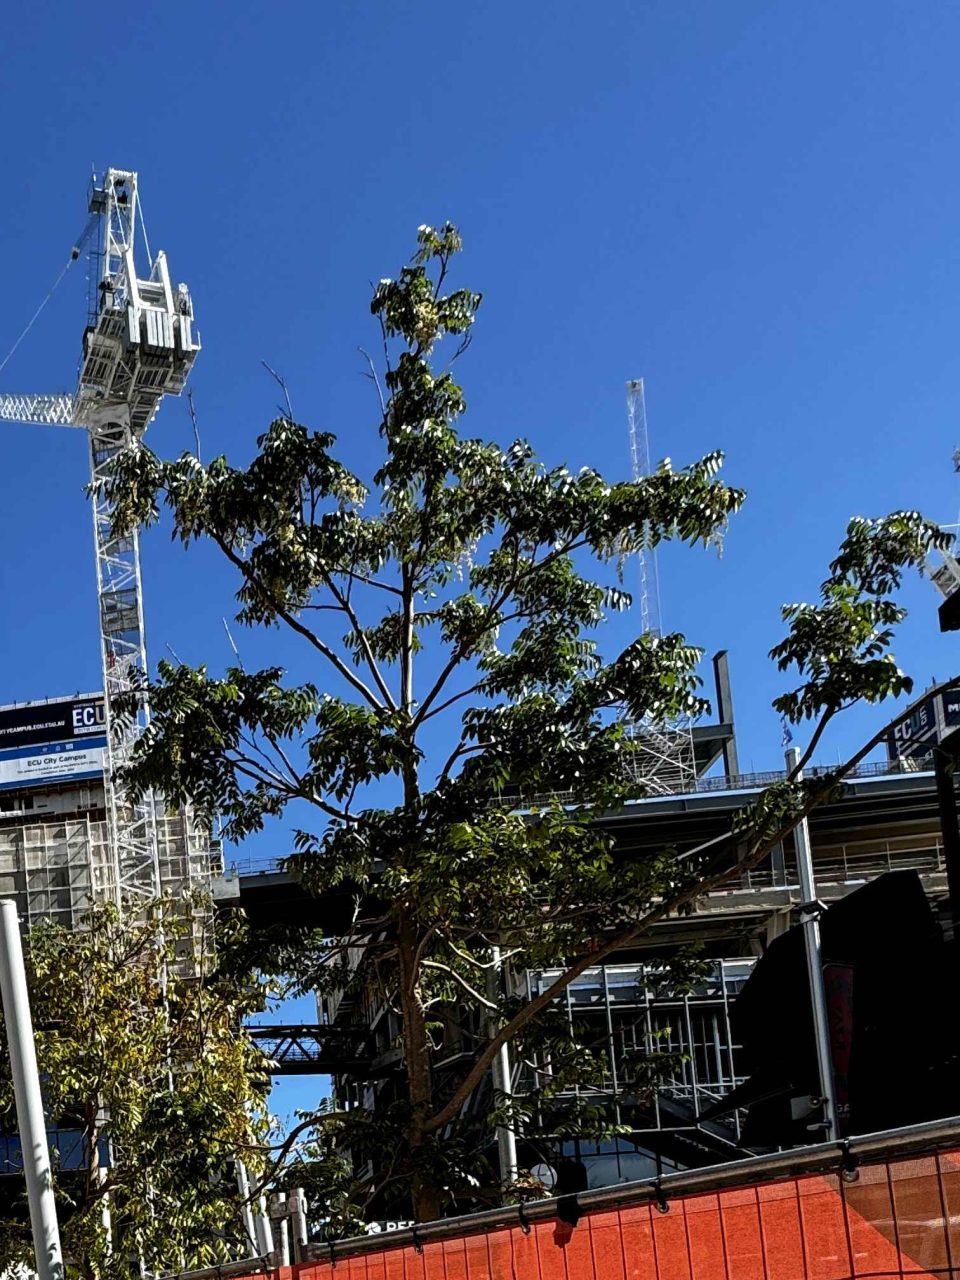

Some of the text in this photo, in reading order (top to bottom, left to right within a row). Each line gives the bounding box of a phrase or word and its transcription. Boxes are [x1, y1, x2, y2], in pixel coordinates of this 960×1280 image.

[72, 704, 107, 727] ECU
[27, 754, 86, 767] ECU City Campus
